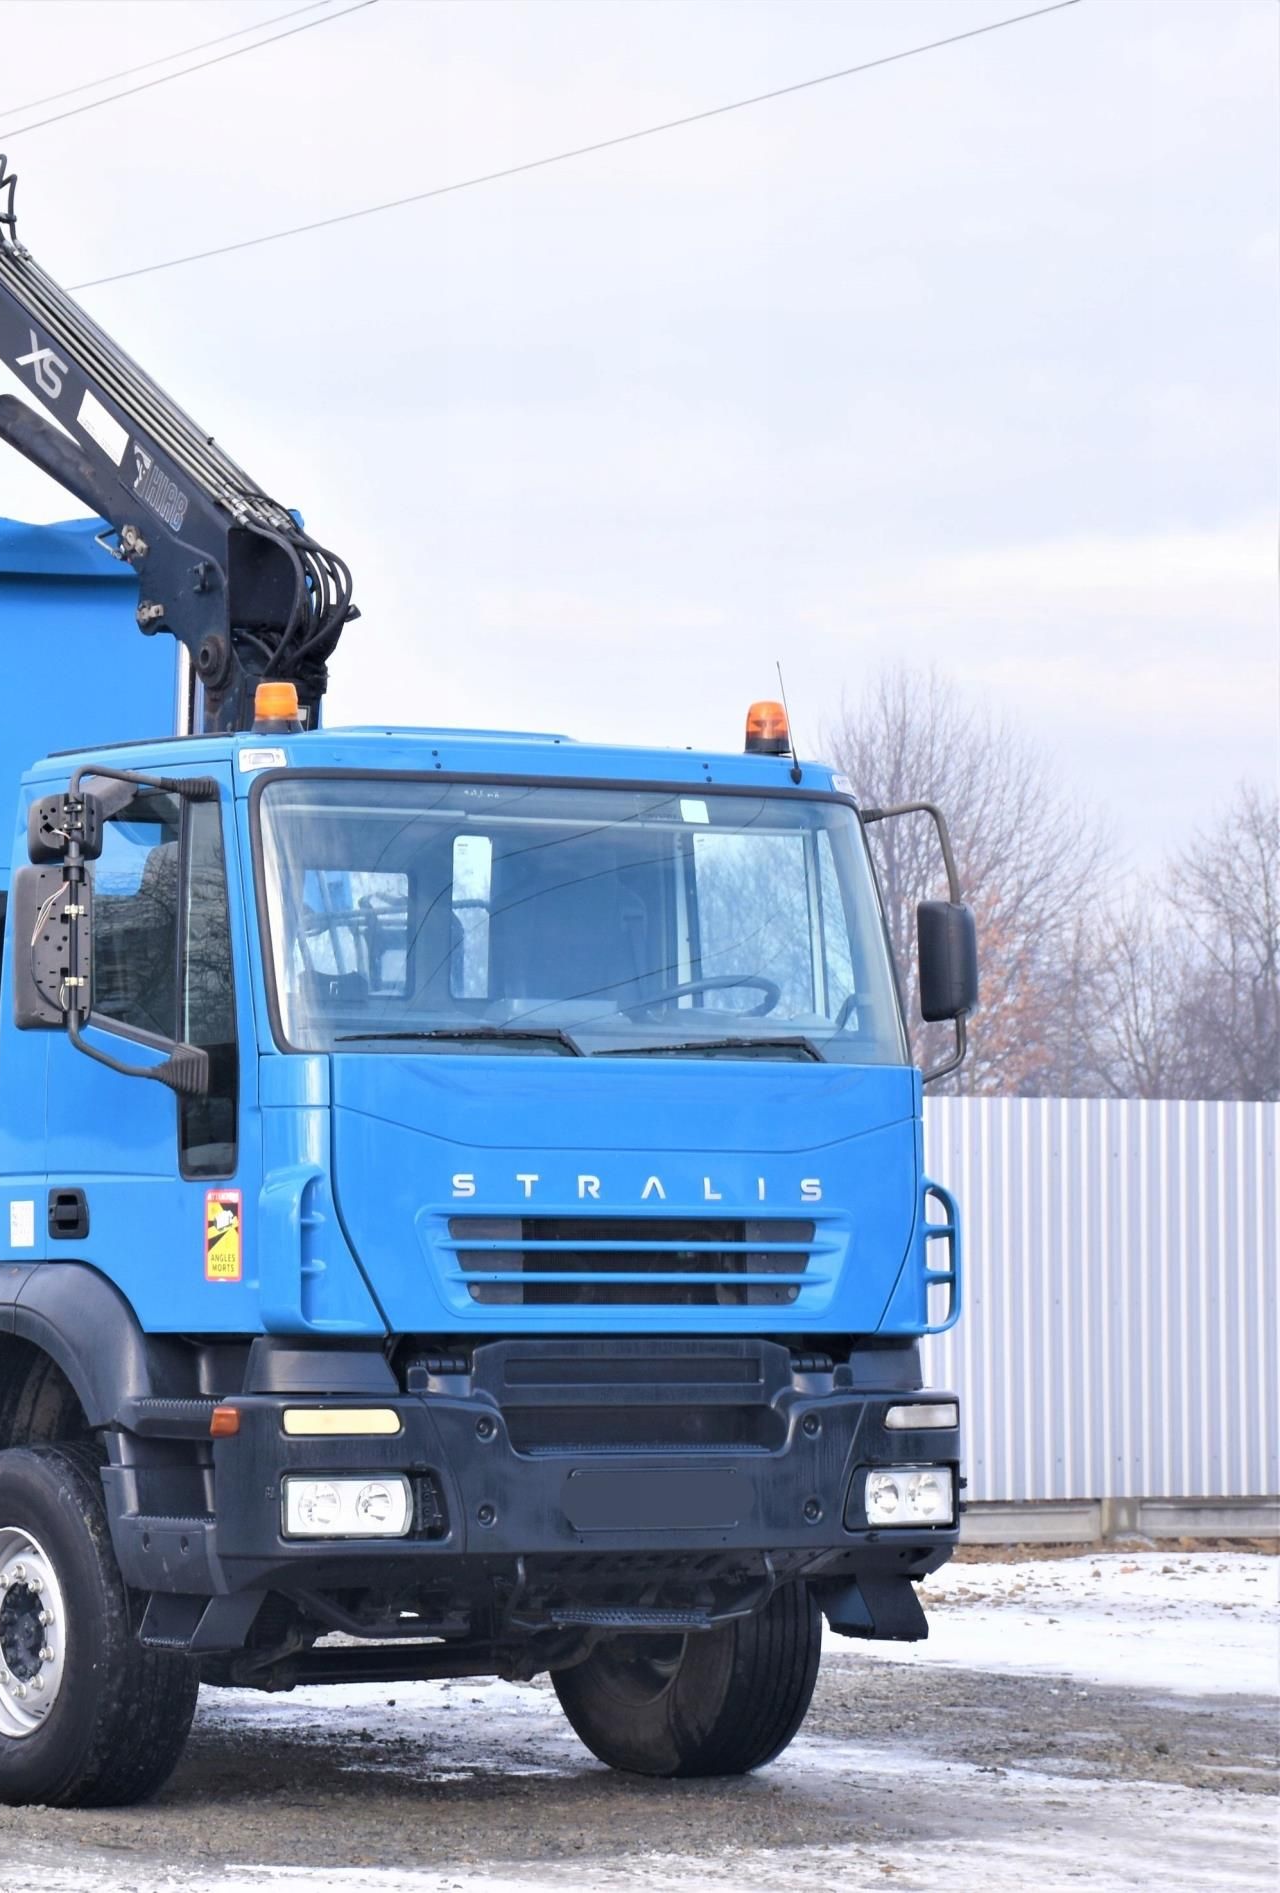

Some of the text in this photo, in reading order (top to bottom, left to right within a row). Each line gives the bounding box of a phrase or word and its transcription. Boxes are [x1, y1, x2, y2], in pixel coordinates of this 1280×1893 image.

[15, 328, 69, 399] XS
[145, 465, 189, 532] HIAB
[452, 1174, 822, 1201] STRALIS
[211, 1254, 236, 1263] ANGLES
[212, 1264, 235, 1272] MORTS
